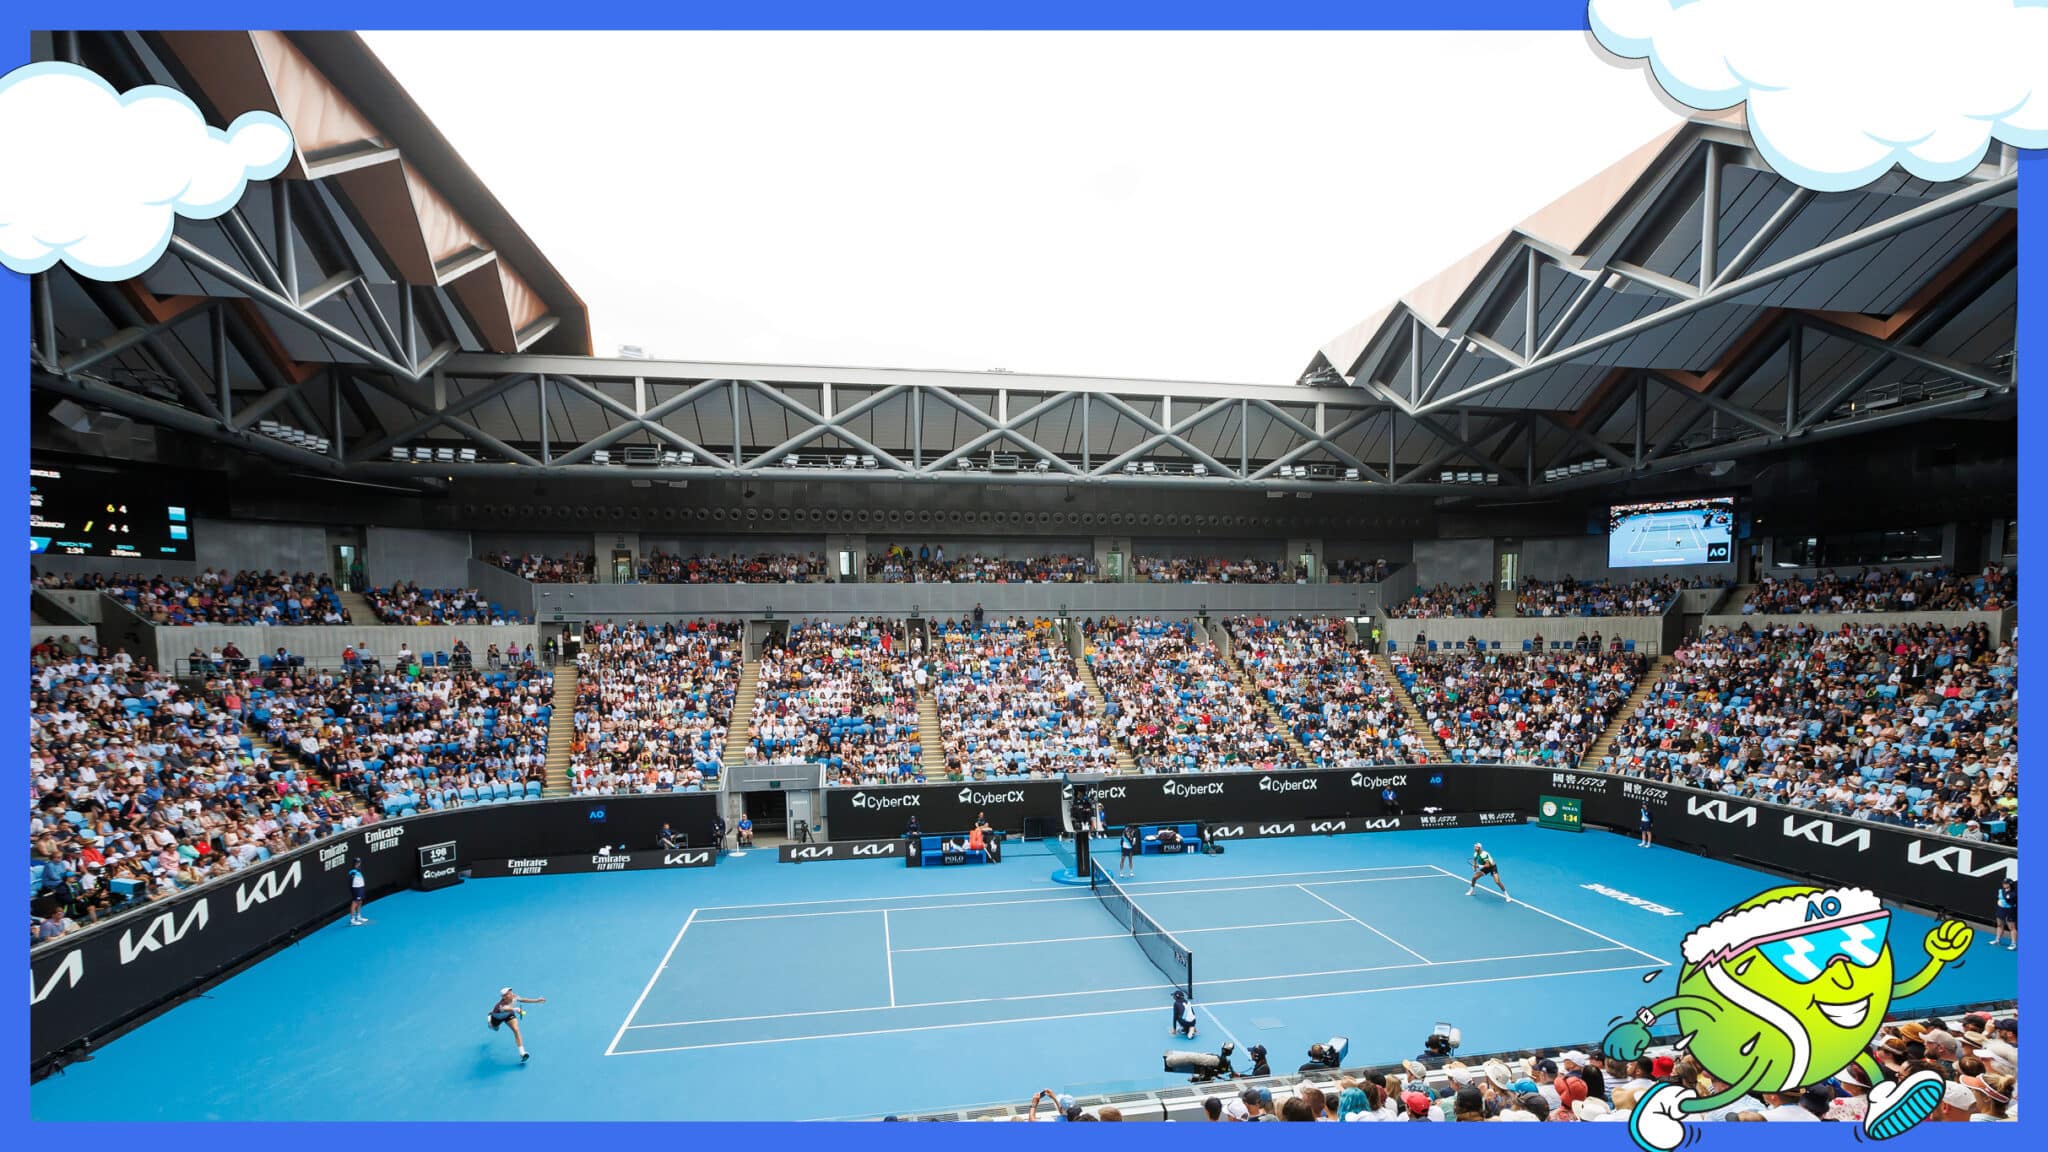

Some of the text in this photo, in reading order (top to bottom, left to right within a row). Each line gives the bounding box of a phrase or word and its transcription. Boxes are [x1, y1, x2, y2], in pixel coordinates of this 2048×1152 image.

[1709, 548, 1727, 557] AO
[1272, 778, 1318, 793] CyberCX
[1363, 775, 1407, 790] CyberCX
[1430, 776, 1442, 784] AO
[1176, 782, 1225, 798] CyberCX
[867, 794, 921, 811] CyberCX
[973, 790, 1025, 806] CyberCX
[589, 811, 605, 819] AO
[1687, 795, 1757, 828] KIA
[1259, 823, 1295, 835] KIA
[1311, 820, 1346, 832] KIA
[1365, 817, 1400, 830] KIA
[365, 825, 404, 844] Emirates
[1783, 814, 1871, 852] KIA
[320, 841, 349, 862] Emirates
[429, 847, 447, 859] 198
[791, 846, 833, 858] KIA
[853, 843, 895, 855] KIA
[508, 858, 548, 868] Emirates
[592, 854, 631, 864] Emirates
[664, 852, 708, 865] KIA
[236, 860, 302, 913] KIA
[119, 898, 209, 965] KIA
